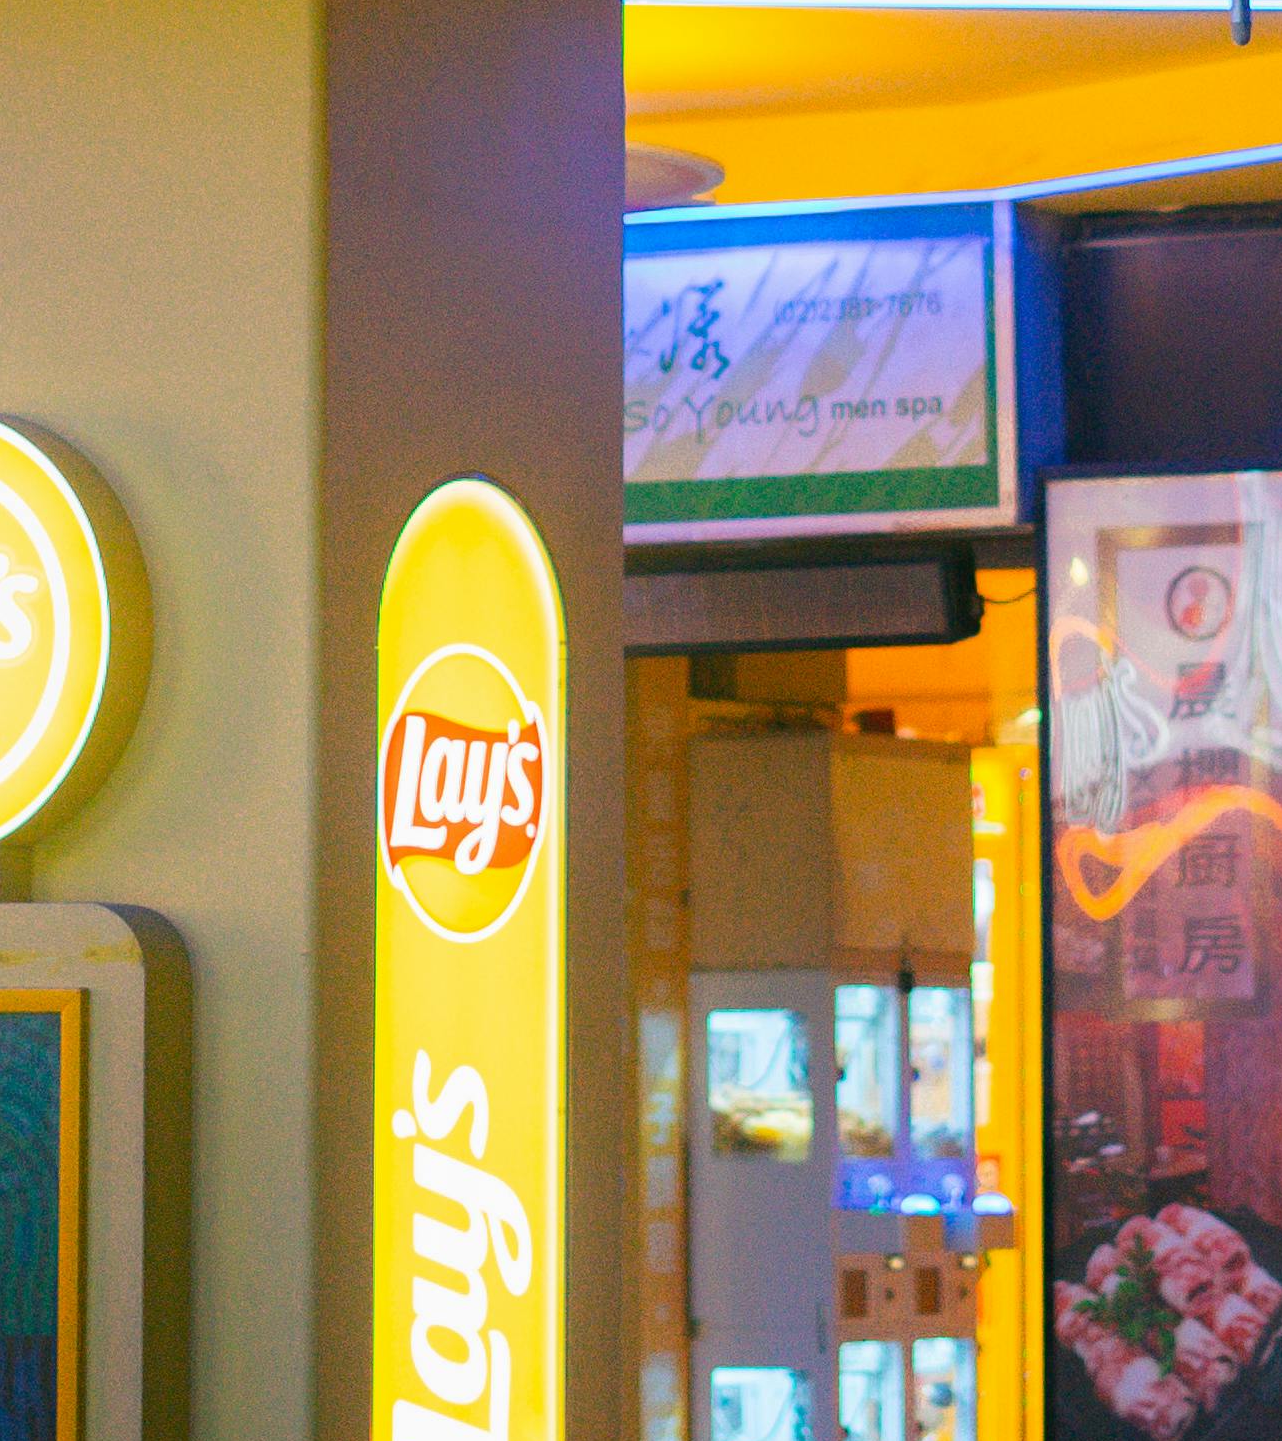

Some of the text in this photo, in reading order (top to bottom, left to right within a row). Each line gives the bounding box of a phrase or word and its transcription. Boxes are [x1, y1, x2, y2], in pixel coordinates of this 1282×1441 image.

[682, 393, 820, 445] Young
[830, 397, 888, 421] men
[894, 393, 944, 420] spa
[389, 713, 539, 876] Lay's
